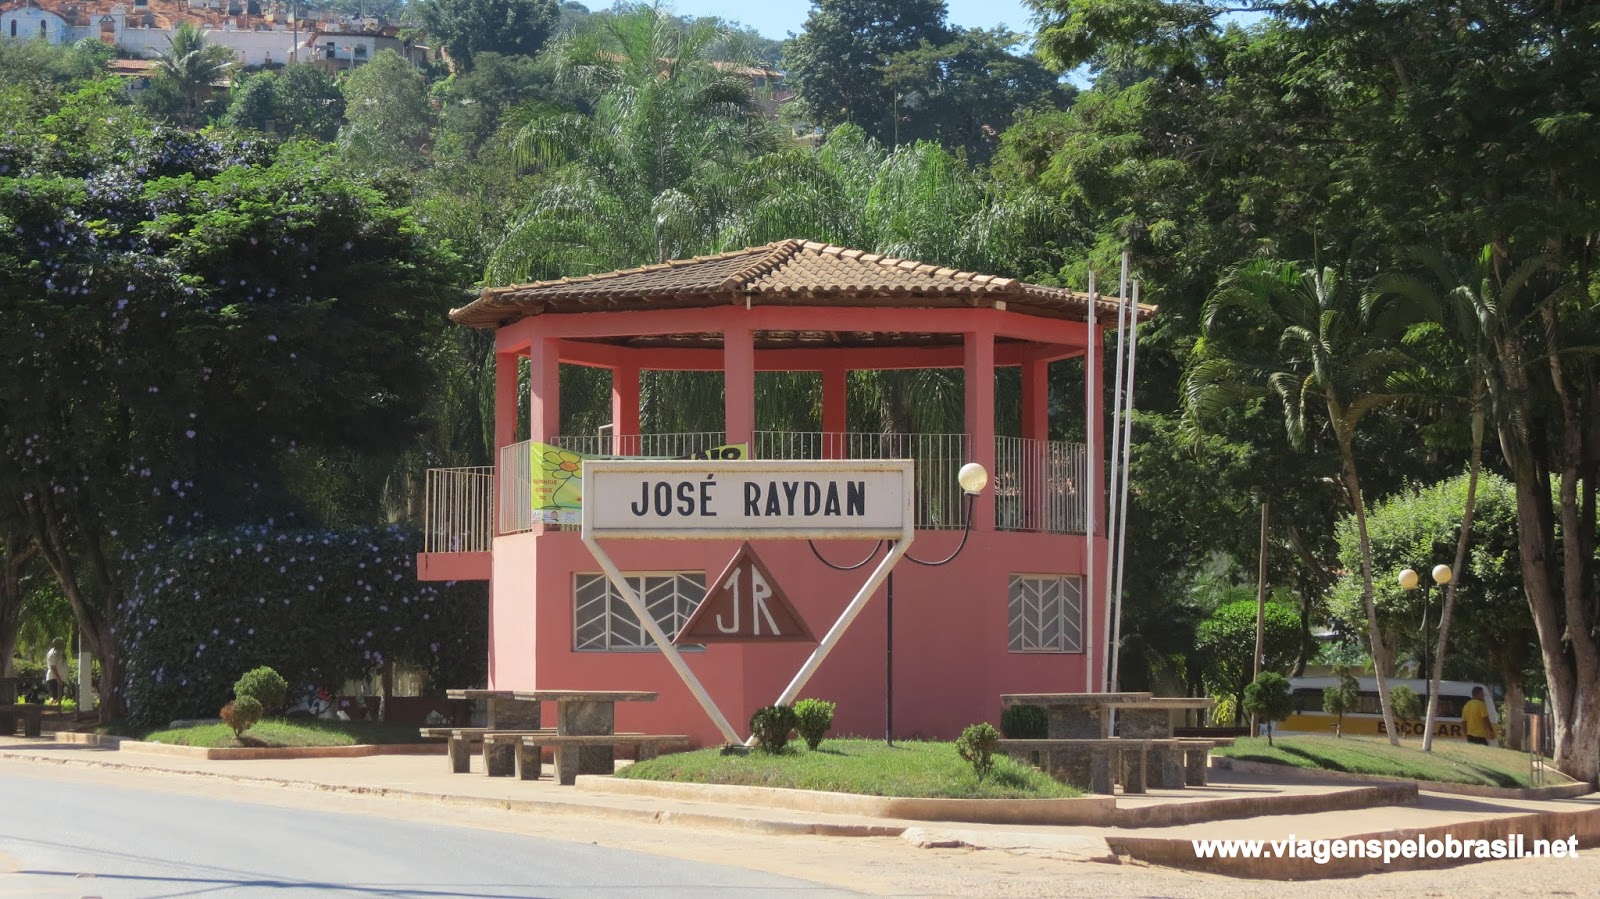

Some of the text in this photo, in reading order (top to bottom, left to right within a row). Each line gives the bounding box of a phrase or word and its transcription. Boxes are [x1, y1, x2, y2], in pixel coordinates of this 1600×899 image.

[630, 473, 866, 517] JOSÉ RAYDAN
[715, 563, 782, 636] JR
[1377, 721, 1462, 737] ECOAR
